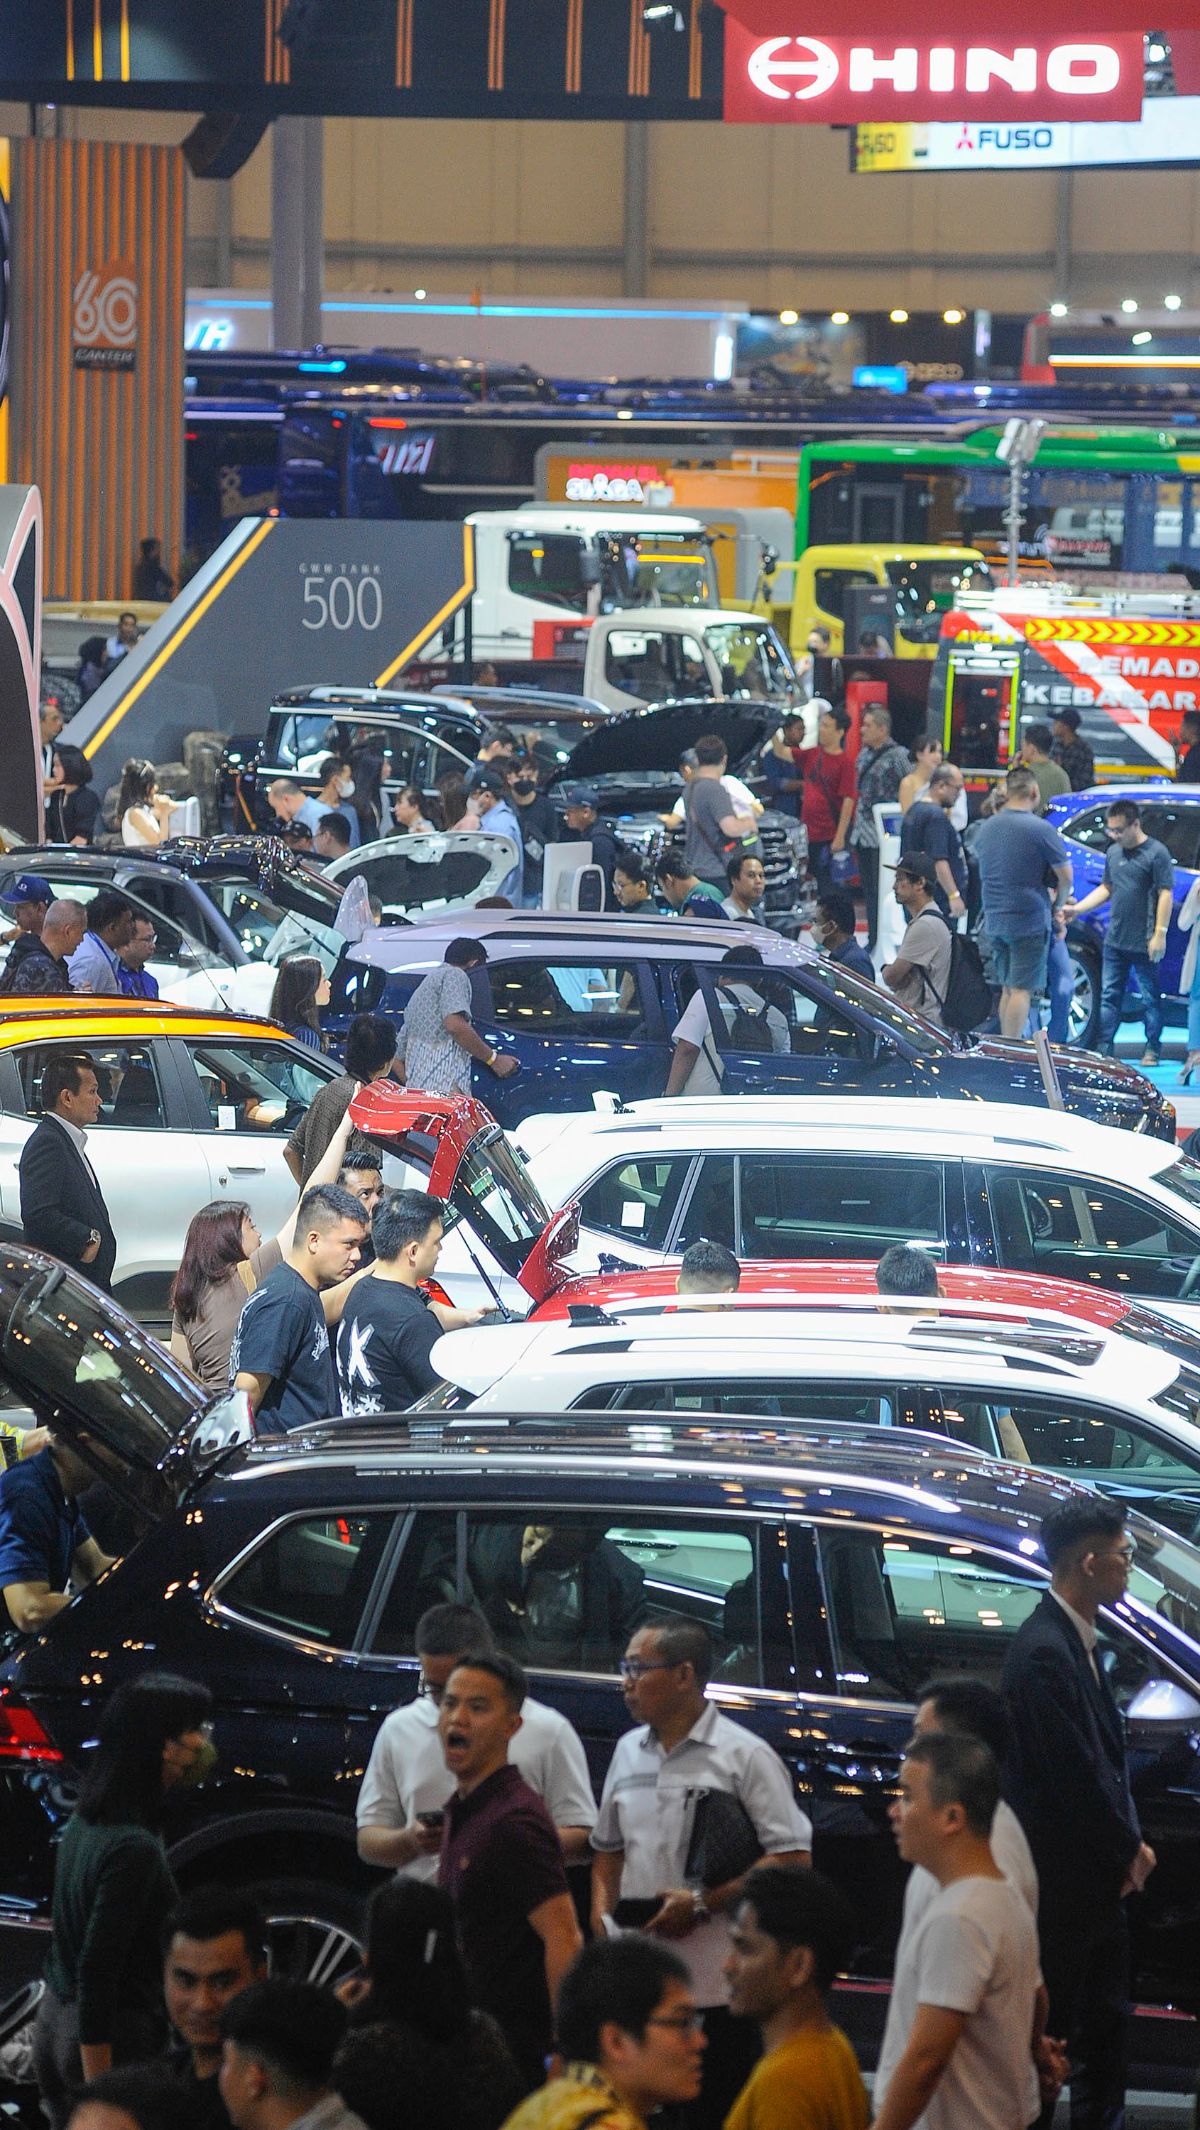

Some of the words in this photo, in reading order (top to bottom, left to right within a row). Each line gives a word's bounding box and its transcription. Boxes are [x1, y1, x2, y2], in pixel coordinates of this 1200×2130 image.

[848, 43, 1121, 95] HINO
[979, 128, 1053, 150] FUSO
[74, 270, 137, 345] 60
[340, 563, 381, 575] TANK
[301, 576, 383, 631] 500
[1079, 655, 1200, 679] PEMAD
[1023, 685, 1200, 711] KEBAKAR
